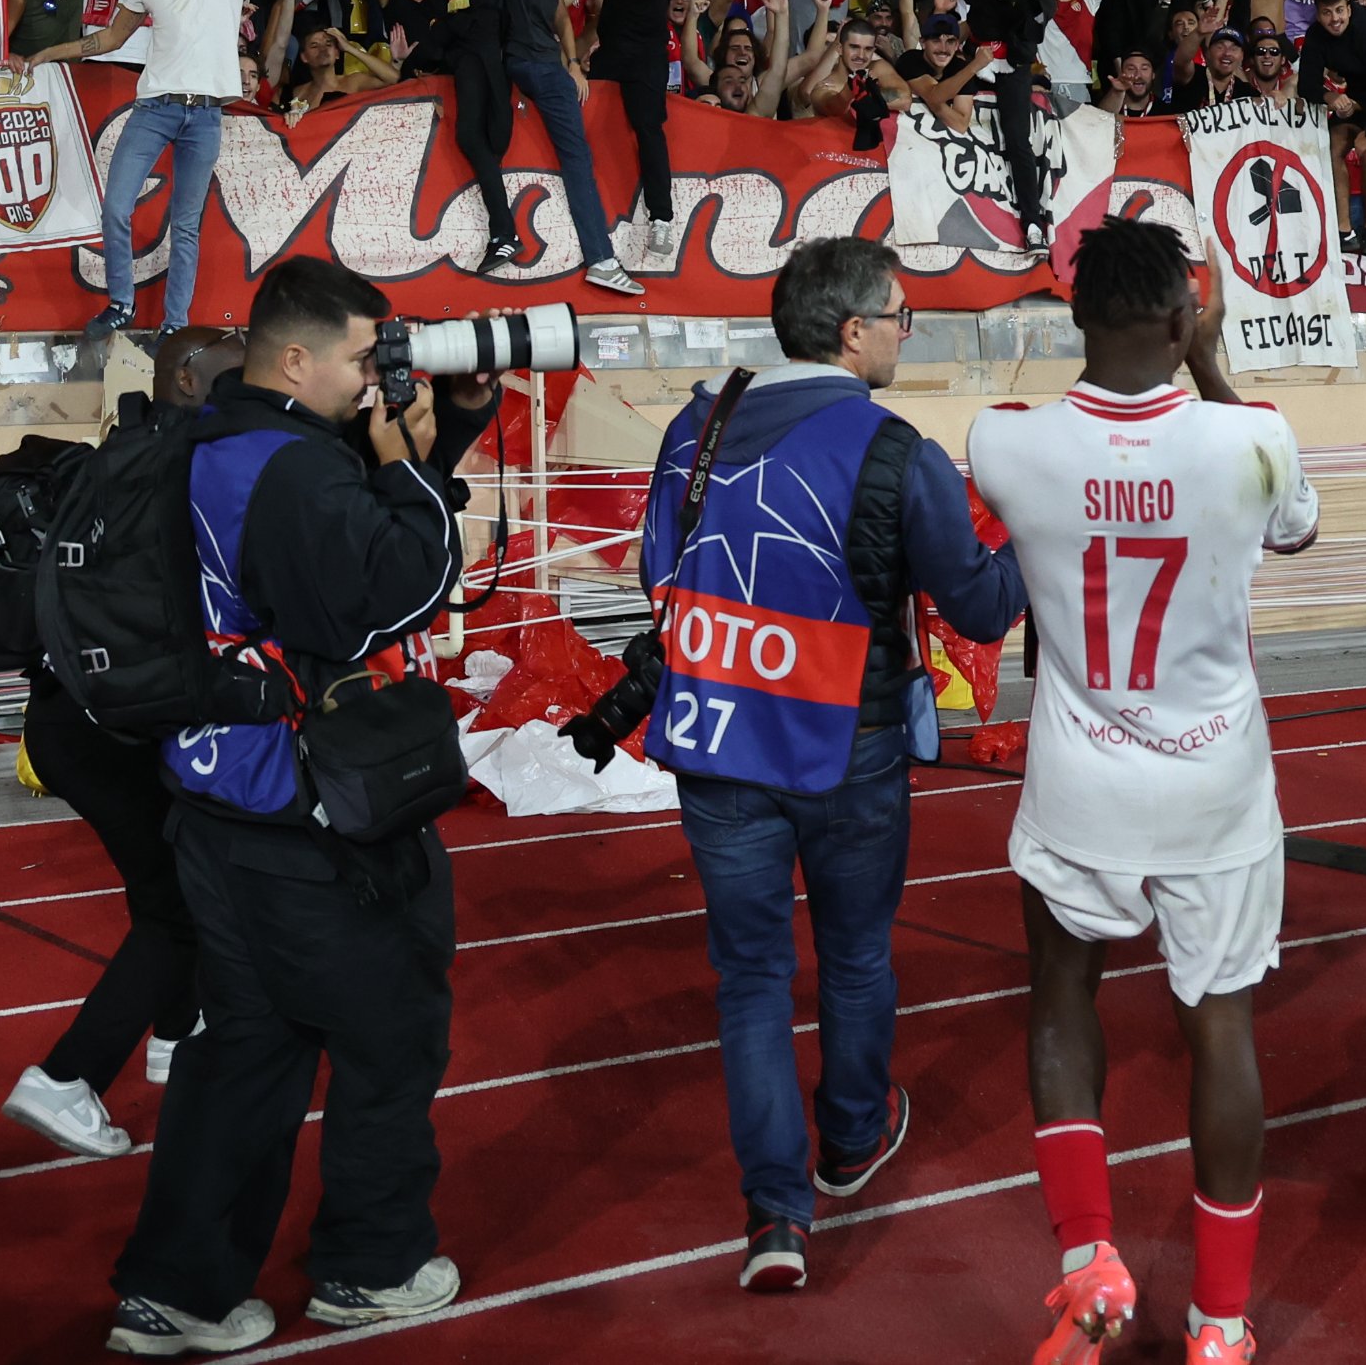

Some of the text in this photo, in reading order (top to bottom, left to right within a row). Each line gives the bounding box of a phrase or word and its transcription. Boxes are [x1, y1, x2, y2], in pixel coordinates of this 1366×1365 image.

[5, 203, 34, 224] ANS
[690, 472, 706, 503] EOS
[699, 452, 711, 469] 5D
[707, 429, 719, 451] Mark
[1084, 479, 1175, 523] SINGO
[1083, 536, 1189, 691] 17
